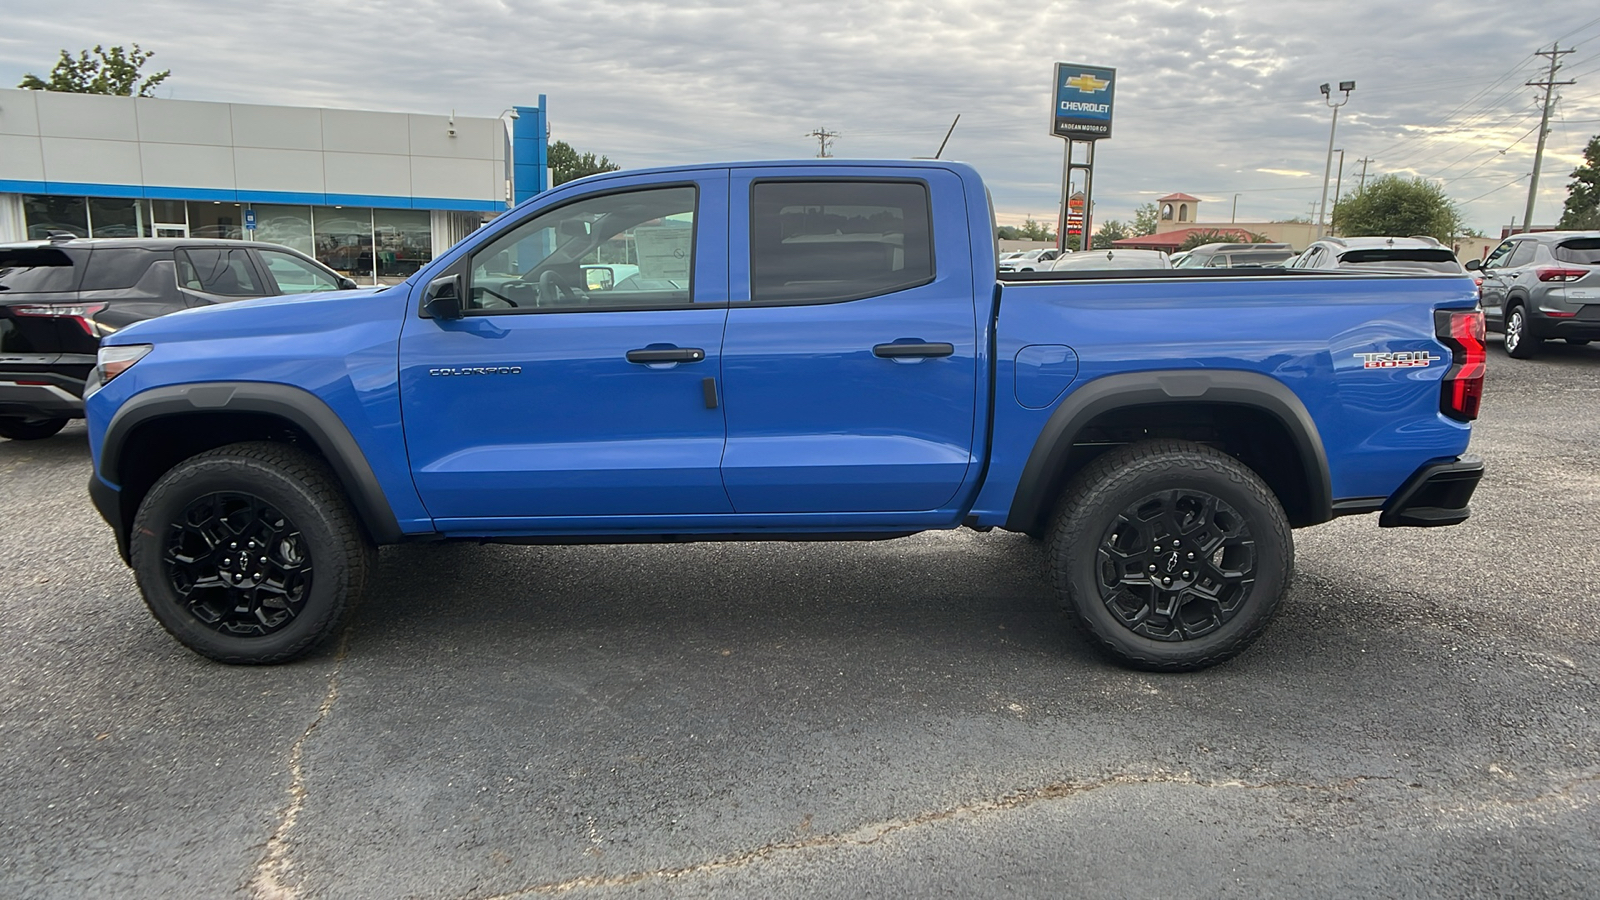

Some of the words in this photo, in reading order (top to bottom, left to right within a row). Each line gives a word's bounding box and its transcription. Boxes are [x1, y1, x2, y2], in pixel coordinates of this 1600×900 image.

[1060, 101, 1110, 113] CHEVROLET
[1060, 122, 1082, 131] ANDEAN
[1081, 124, 1100, 132] MOTOR
[1353, 351, 1440, 362] TRAIL
[1364, 360, 1429, 369] BOSS
[429, 366, 522, 376] COLORADO
